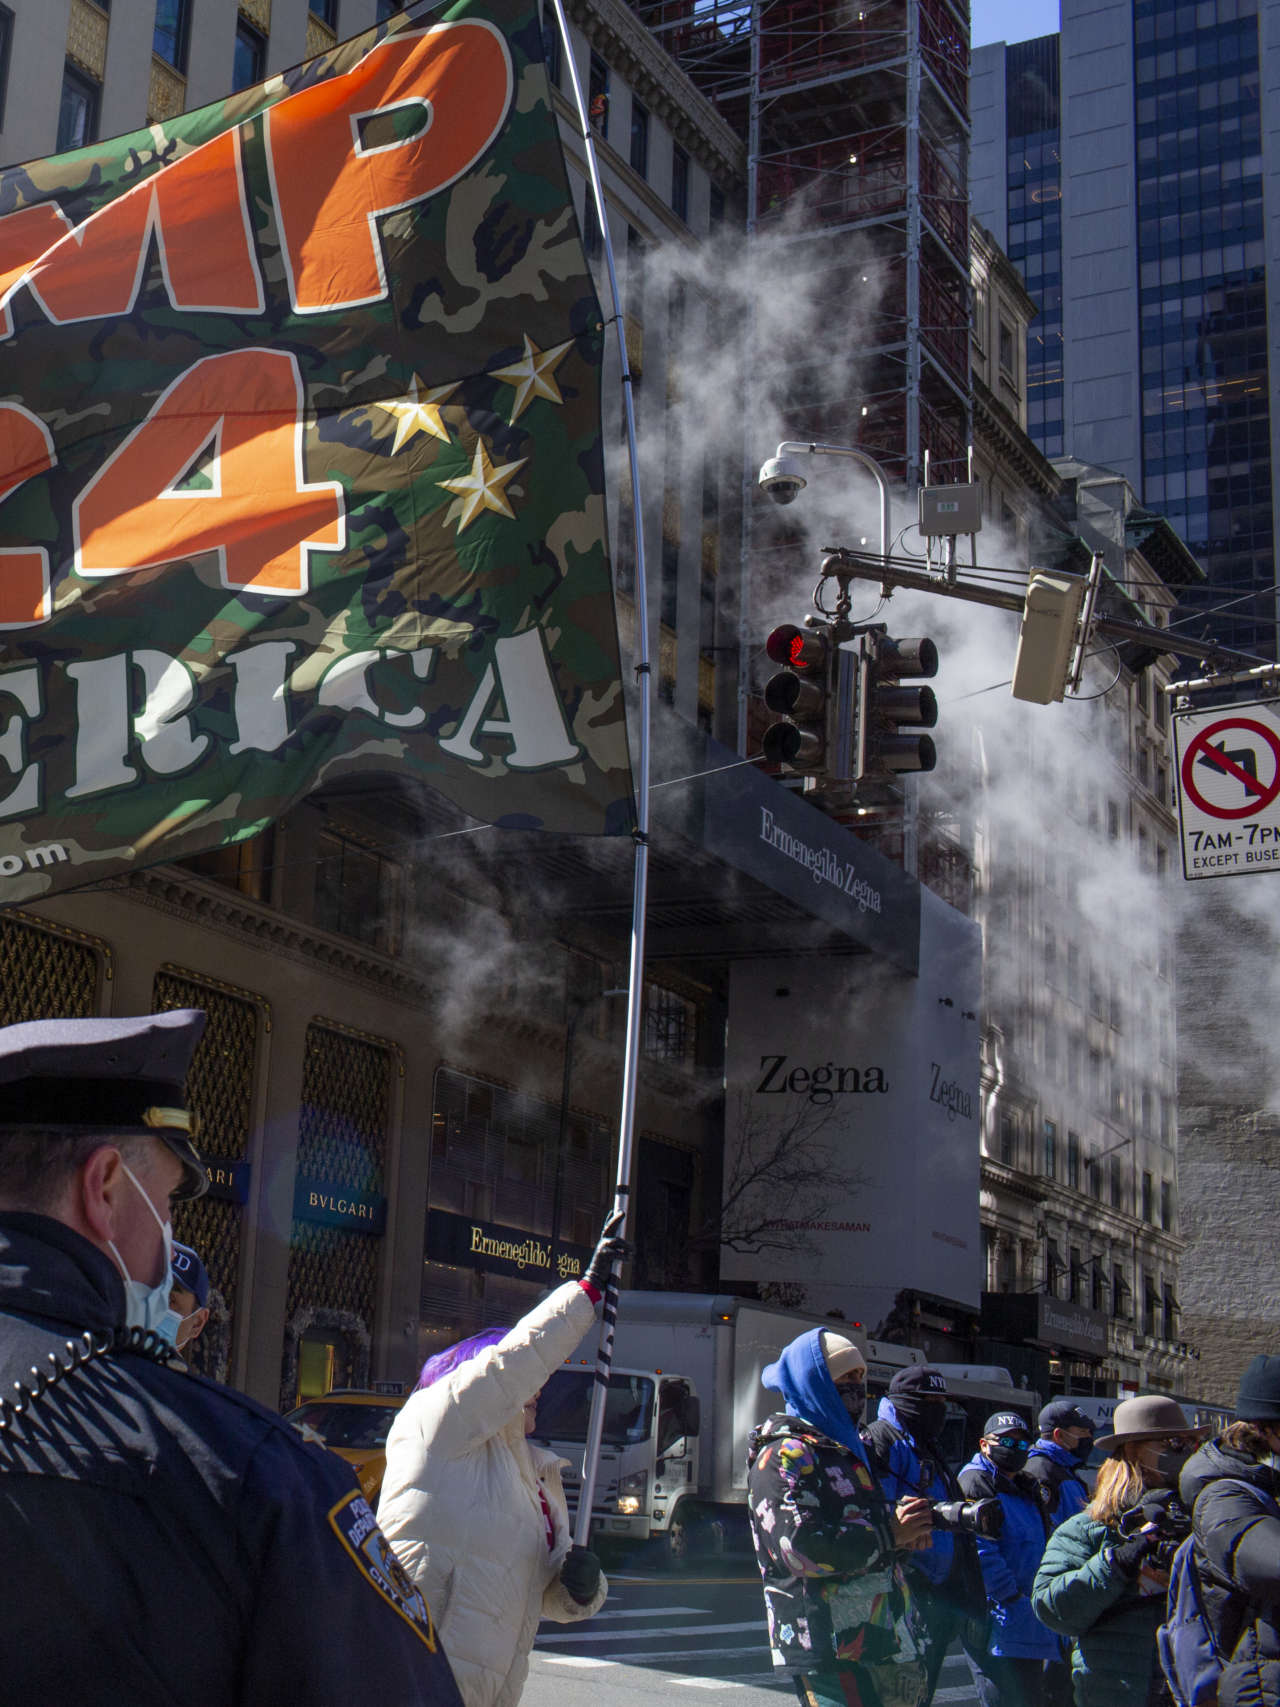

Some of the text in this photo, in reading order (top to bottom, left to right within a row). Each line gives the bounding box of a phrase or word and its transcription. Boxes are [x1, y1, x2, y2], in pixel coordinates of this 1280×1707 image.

[760, 806, 881, 914] Ermenegildo Zegna
[1193, 848, 1280, 869] EXCEPT BUSE
[756, 1055, 889, 1105] Zegna
[929, 1062, 972, 1122] Zegna
[309, 1192, 374, 1220] BVLGARI
[470, 1226, 546, 1270] Ermenegildo
[370, 1566, 400, 1601] CITY
